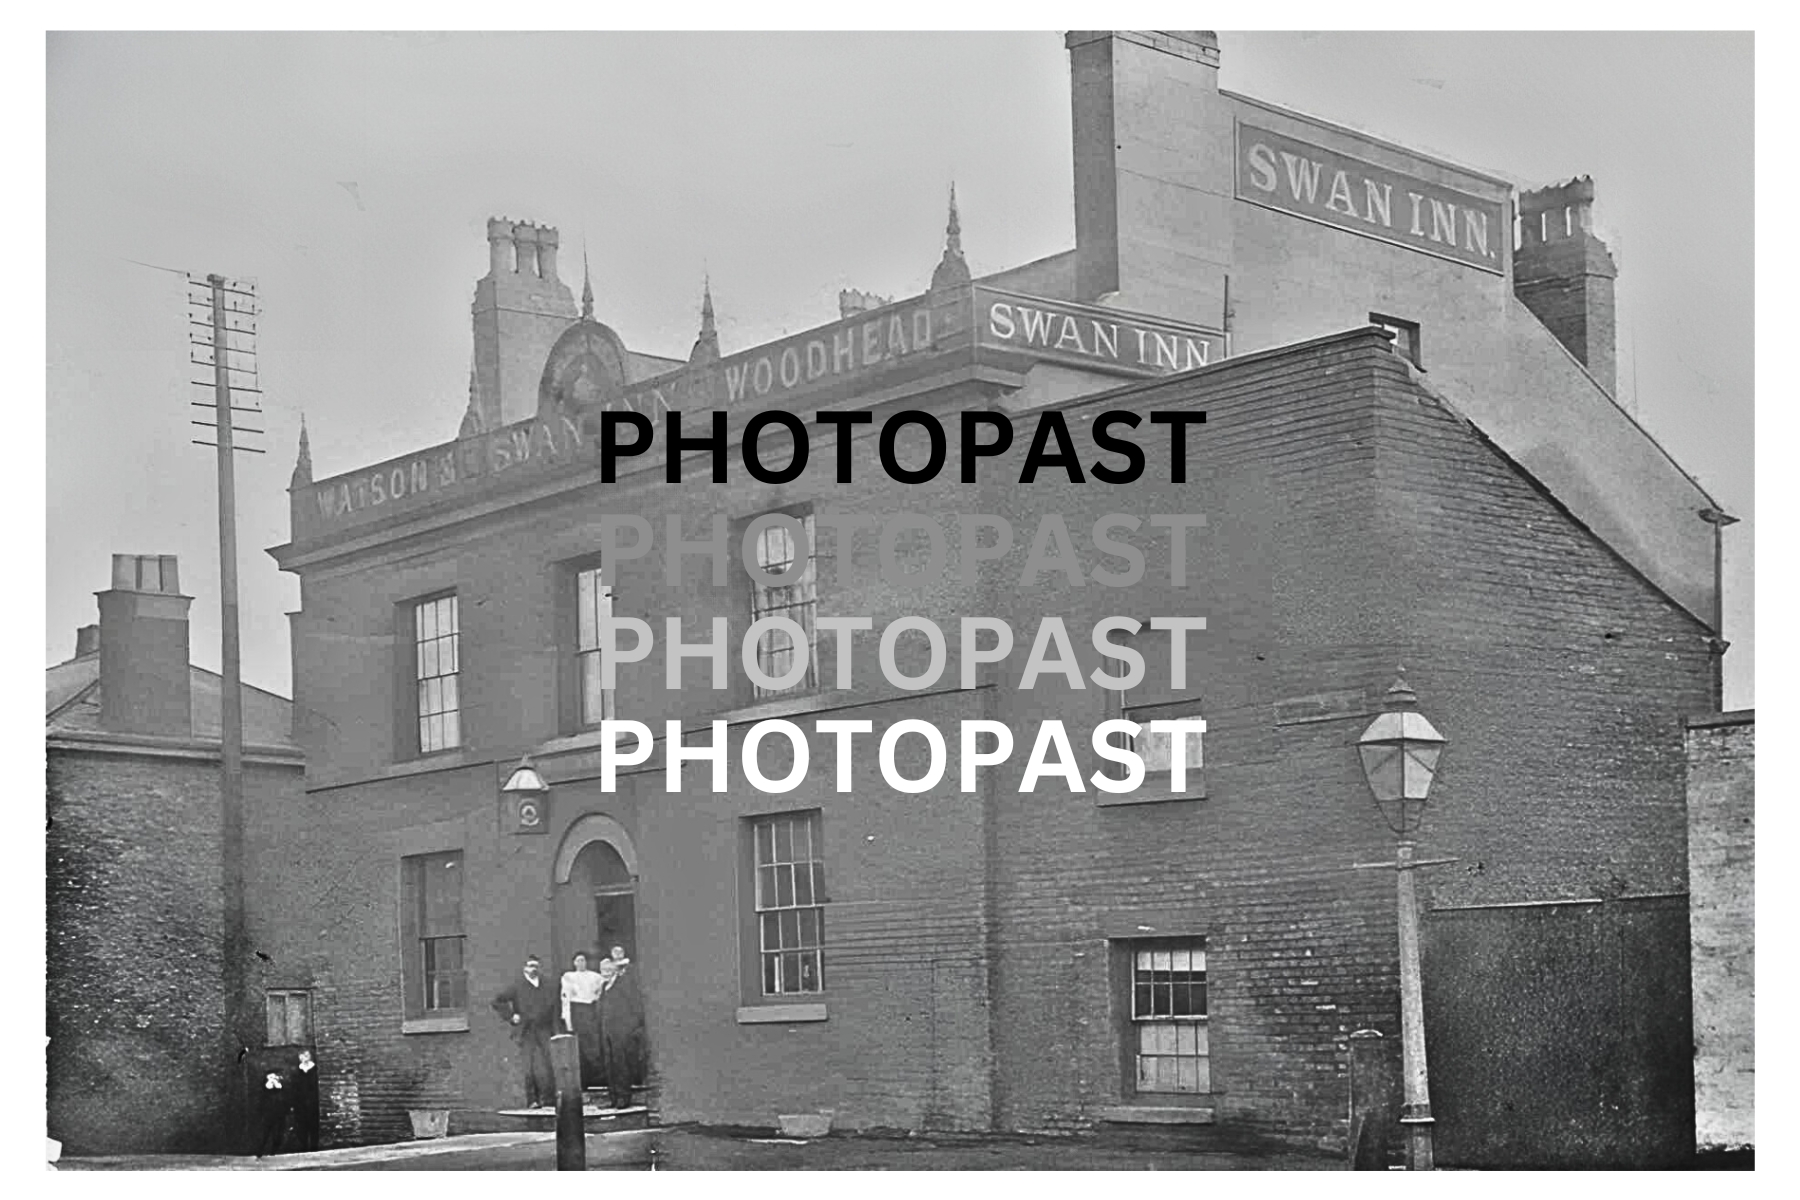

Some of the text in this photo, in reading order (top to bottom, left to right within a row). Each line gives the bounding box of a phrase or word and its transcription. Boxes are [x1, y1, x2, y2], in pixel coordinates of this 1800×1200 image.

[1249, 143, 1393, 228] SWAN
[724, 309, 931, 403] WOODHEAD
[990, 301, 1211, 370] SWAN INN
